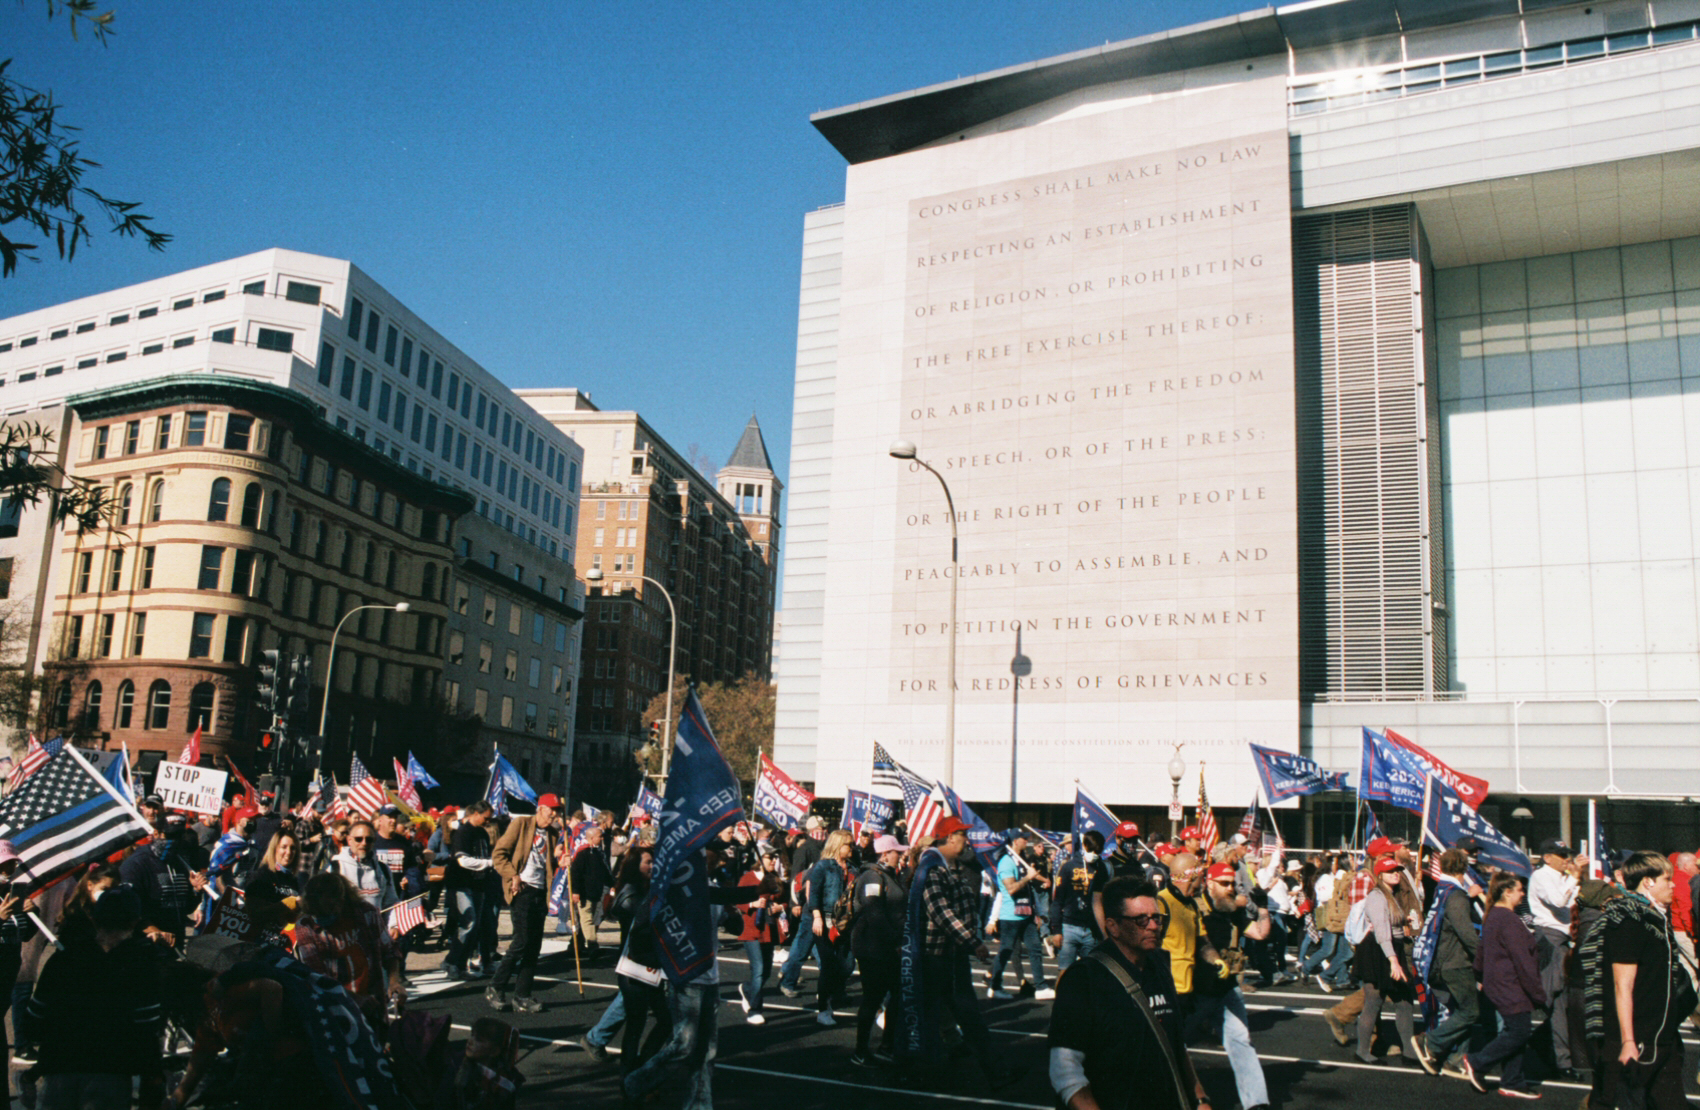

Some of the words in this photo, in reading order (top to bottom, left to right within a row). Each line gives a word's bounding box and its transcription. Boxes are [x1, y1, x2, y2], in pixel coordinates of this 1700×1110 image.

[919, 190, 1020, 218] CONGRESS
[1034, 177, 1093, 195] SHALL
[1107, 164, 1161, 183] MAKE
[1178, 156, 1206, 171] NO
[1218, 145, 1261, 163] LAW
[918, 238, 1034, 268] RESPECTING
[1046, 232, 1070, 246] AN
[1084, 200, 1260, 240] ESTABLISHMENT
[915, 304, 936, 317] OF
[1068, 280, 1094, 294] OR
[1108, 255, 1262, 288] PROHIBITING
[914, 353, 950, 368] THE
[966, 345, 1010, 362] FREE
[1027, 329, 1128, 356] EXERCISE
[911, 407, 937, 420] OR
[949, 388, 1075, 417] ABRIDGING
[1091, 384, 1131, 399] THE
[1149, 370, 1263, 393] FREEDOM
[1045, 446, 1072, 459] OR
[1086, 442, 1109, 455] OF
[1125, 436, 1168, 452] THE
[907, 514, 931, 526] OR
[943, 510, 981, 523] THE
[994, 503, 1063, 519] RIGHT
[1077, 500, 1102, 513] OF
[1116, 495, 1159, 510] THE
[1179, 487, 1266, 505] PEOPLE
[905, 563, 1019, 580] PEACEABLY
[1034, 560, 1061, 573] TO
[1218, 548, 1268, 562] AND
[902, 623, 927, 636] TO
[940, 619, 1039, 634] PETITION
[1052, 617, 1092, 630] THE
[1105, 608, 1266, 628] GOVERNMENT
[900, 679, 937, 692] FOR
[972, 676, 1064, 691] REDRESS
[1077, 676, 1102, 689] OF
[1117, 672, 1267, 690] GRIEVANCES
[164, 765, 201, 784] STOP
[200, 785, 217, 795] THE
[219, 913, 250, 934] YOU
[221, 905, 250, 921] SUPPO
[660, 904, 697, 960] REAT!
